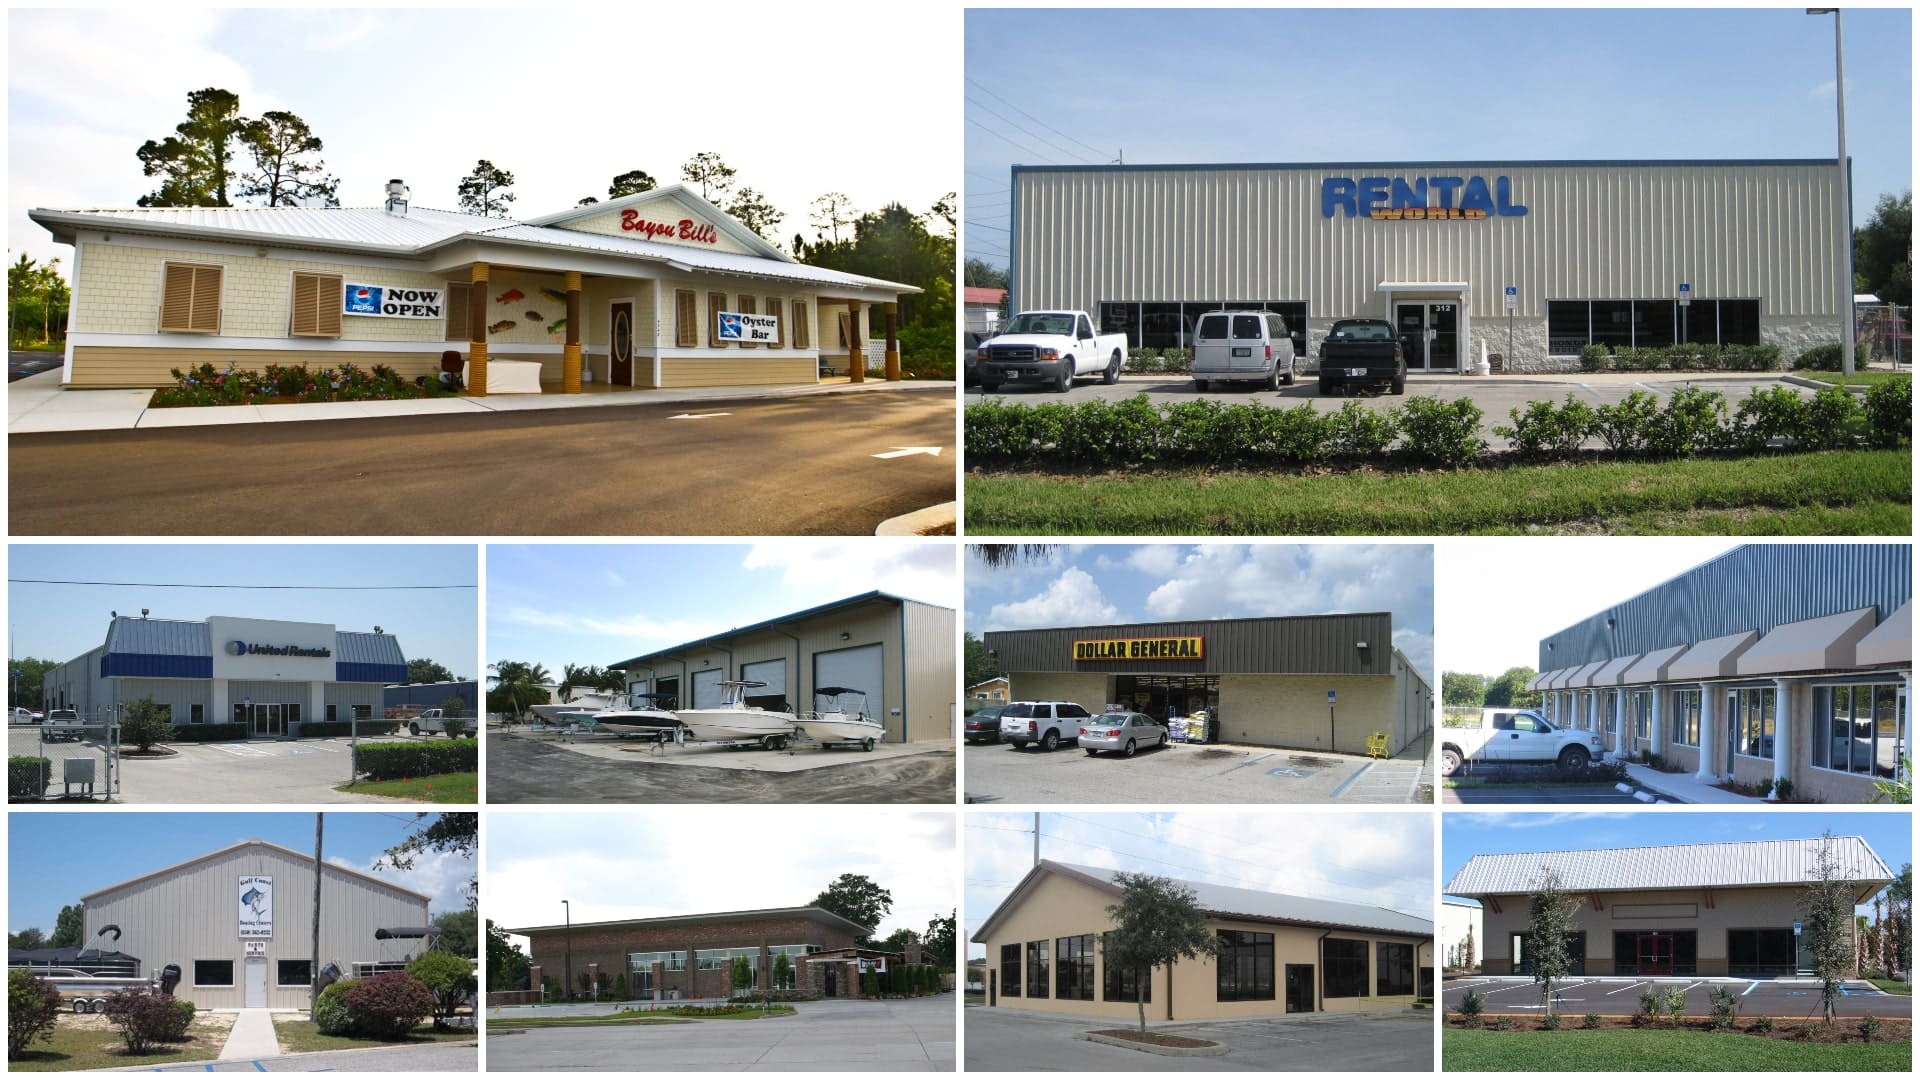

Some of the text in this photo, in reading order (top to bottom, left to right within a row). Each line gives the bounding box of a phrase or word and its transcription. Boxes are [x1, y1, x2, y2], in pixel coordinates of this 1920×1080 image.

[1321, 175, 1529, 219] RENTAL
[1370, 207, 1489, 220] WORLD
[621, 209, 718, 244] Bayou Bill's
[388, 289, 438, 303] NOW
[352, 304, 375, 312] PEPSI
[383, 303, 440, 317] OPEN
[742, 316, 776, 328] Oyster
[751, 329, 769, 339] Bar
[248, 643, 331, 658] United Rentals
[1077, 639, 1198, 658] DOLLAR GENERAL
